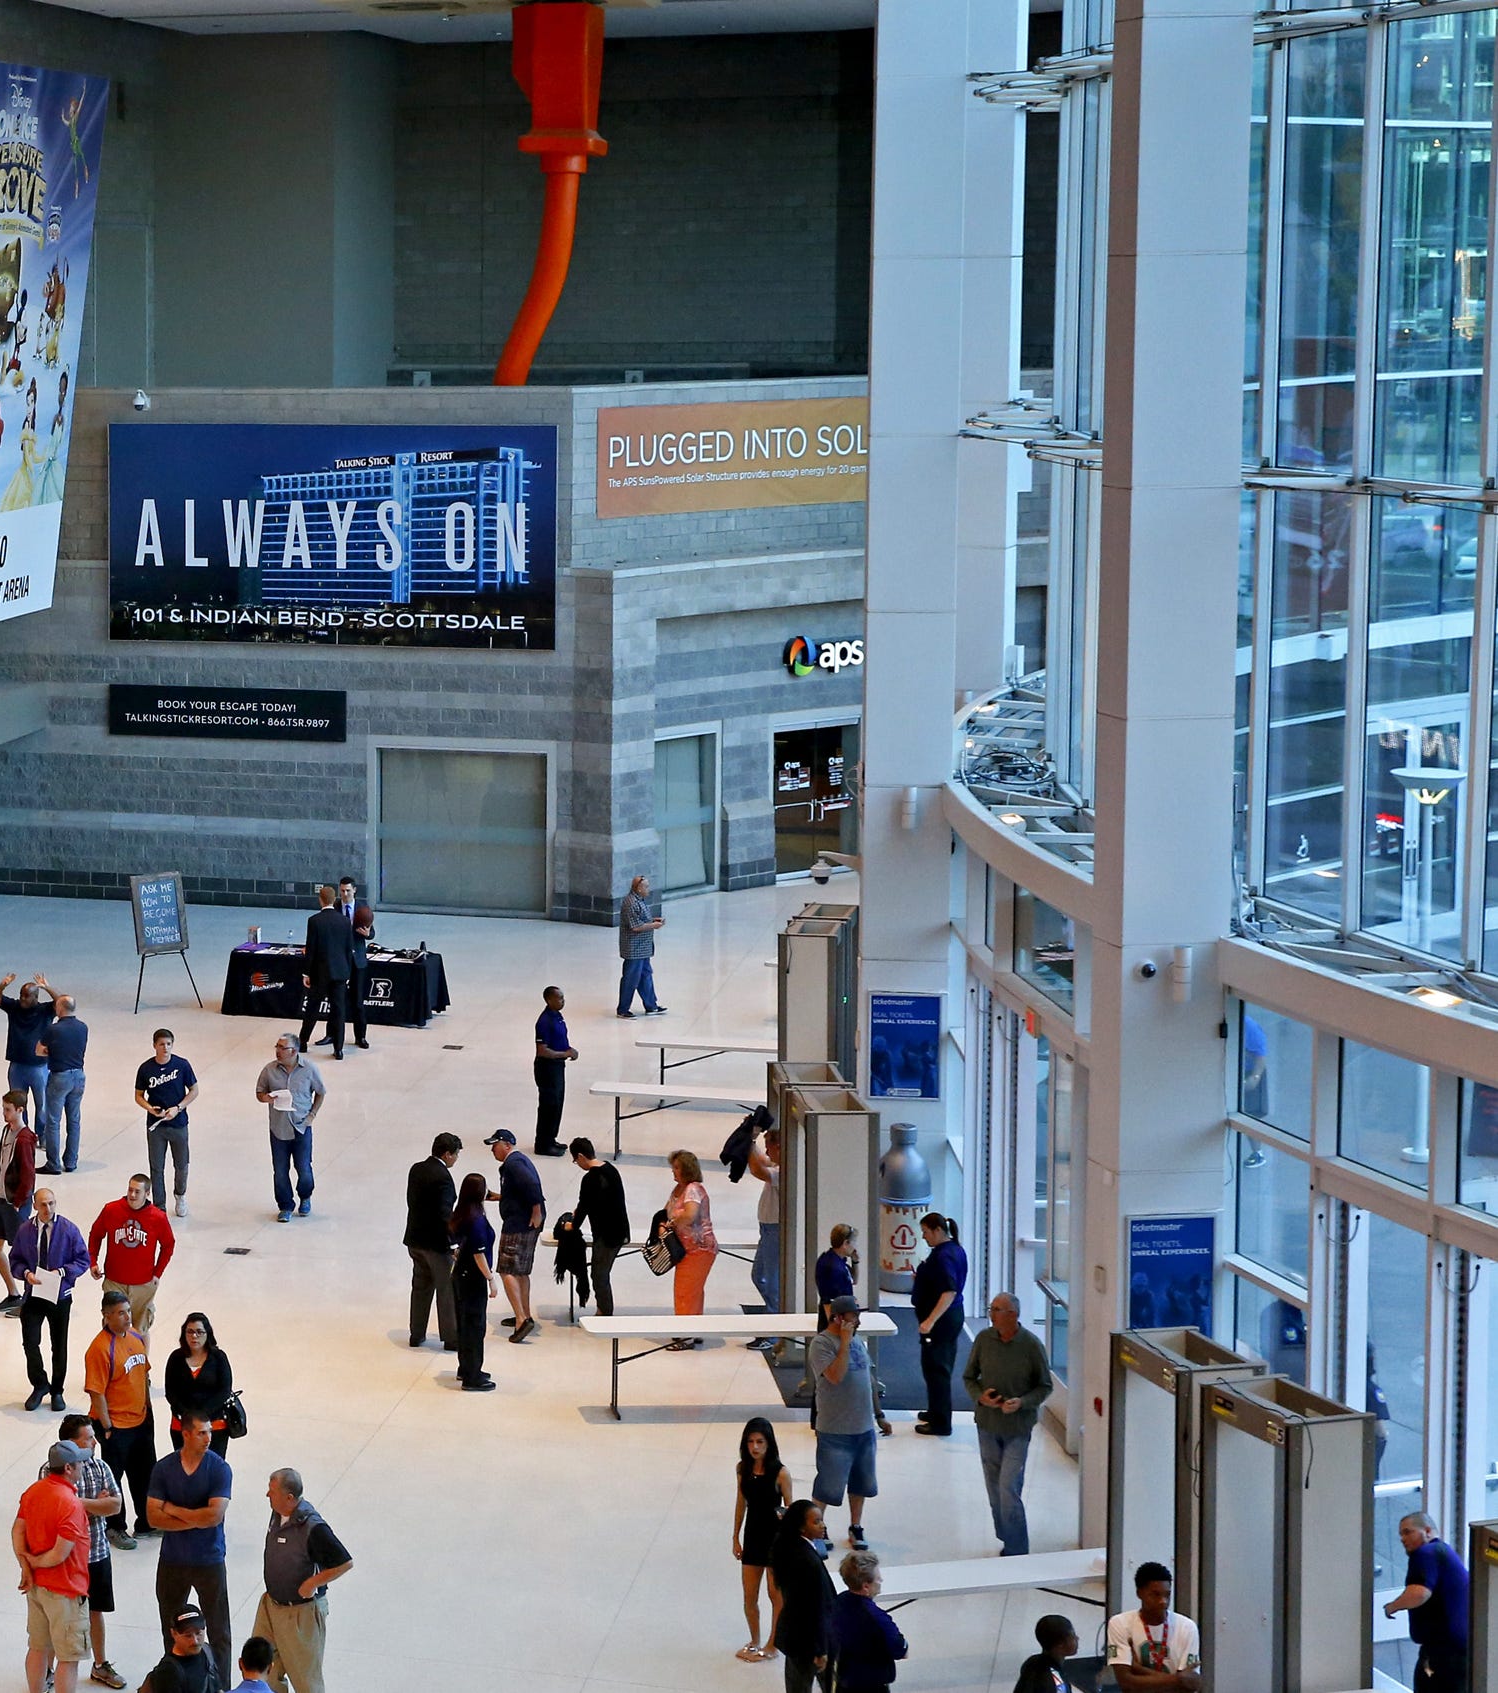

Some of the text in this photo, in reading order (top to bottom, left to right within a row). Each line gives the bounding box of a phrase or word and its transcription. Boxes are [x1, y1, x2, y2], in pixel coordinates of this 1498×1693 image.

[608, 424, 868, 468] PLUGGED INTO SOL
[334, 450, 454, 470] TALKING STICK RESORT
[608, 464, 849, 488] The APS SunsPowered Solar Structure provides enough energy for 20
[134, 498, 526, 573] ALWAYS ON
[3, 575, 29, 603] ARENA
[132, 608, 526, 631] 101 & INDIAN BEND SCOTTSDALE
[819, 640, 865, 673] aps
[157, 699, 297, 713] BOOK YOUR ESCAPE TODAY!
[125, 712, 330, 728] TALKINGSTICKRESORT.COM 866.TSR.9897
[141, 884, 157, 895] ASK
[141, 895, 171, 908] HOW TO
[143, 908, 177, 919] BECOME
[363, 1000, 394, 1008] RATTLERS
[873, 998, 915, 1006] ticketmaster
[148, 1068, 180, 1089] Detroit
[1132, 1223, 1183, 1232] ticketmaster
[129, 1225, 148, 1247] STATE
[1132, 1241, 1150, 1249] REAL
[1277, 1429, 1284, 1442] 5
